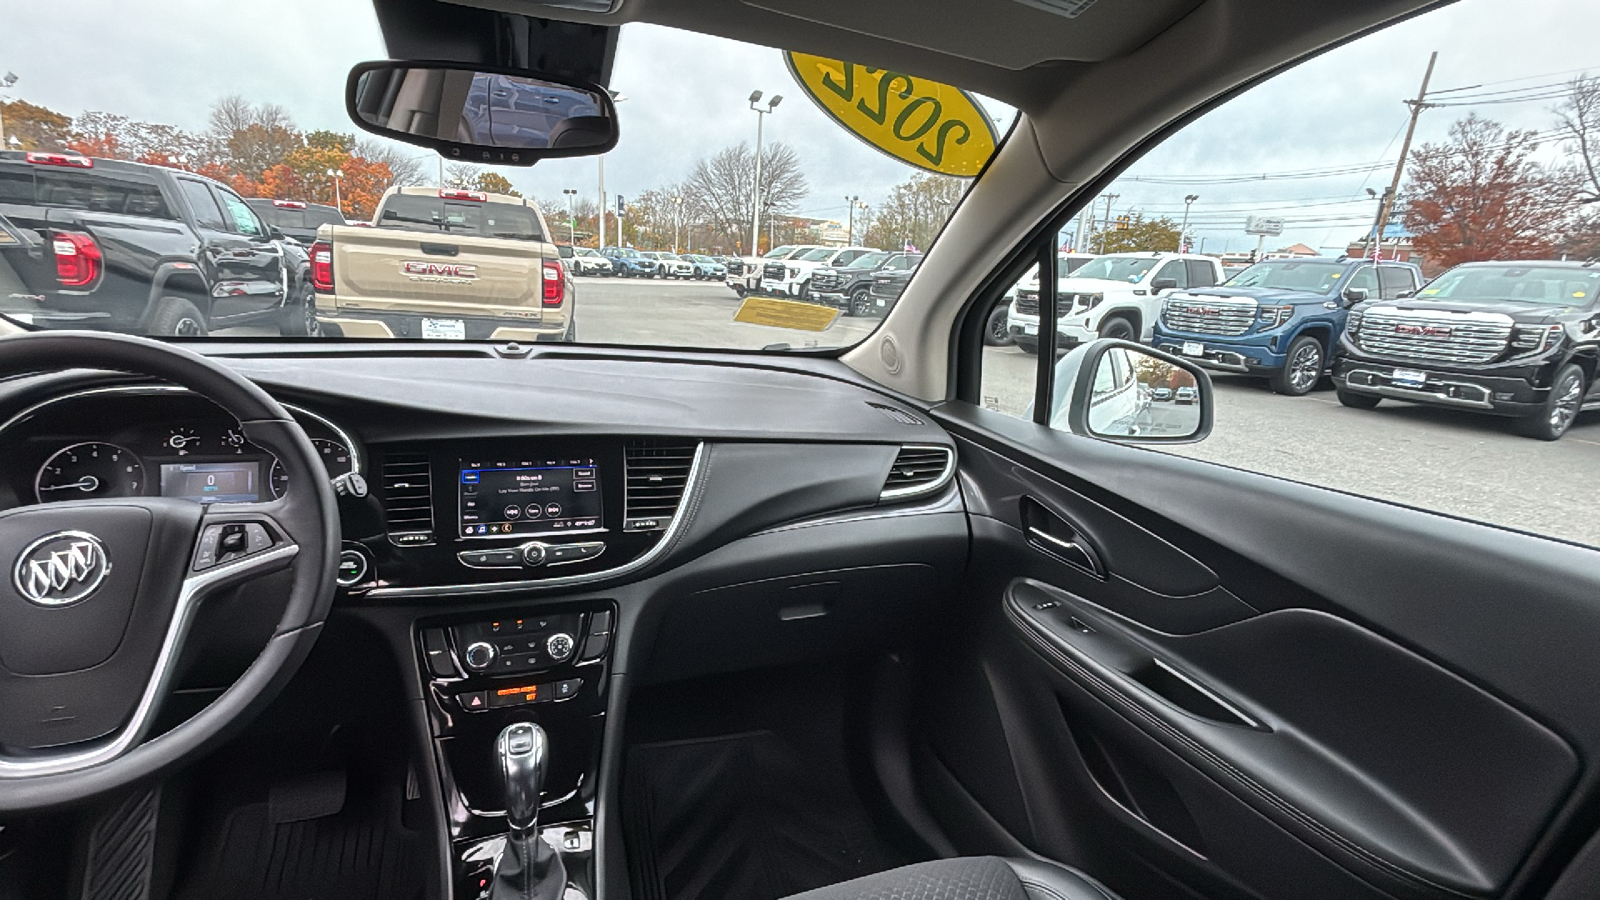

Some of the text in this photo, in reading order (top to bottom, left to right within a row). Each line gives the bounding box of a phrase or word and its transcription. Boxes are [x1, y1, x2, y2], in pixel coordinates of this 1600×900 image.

[405, 261, 476, 278] GMC
[1394, 324, 1453, 338] GMC
[206, 474, 216, 486] 0
